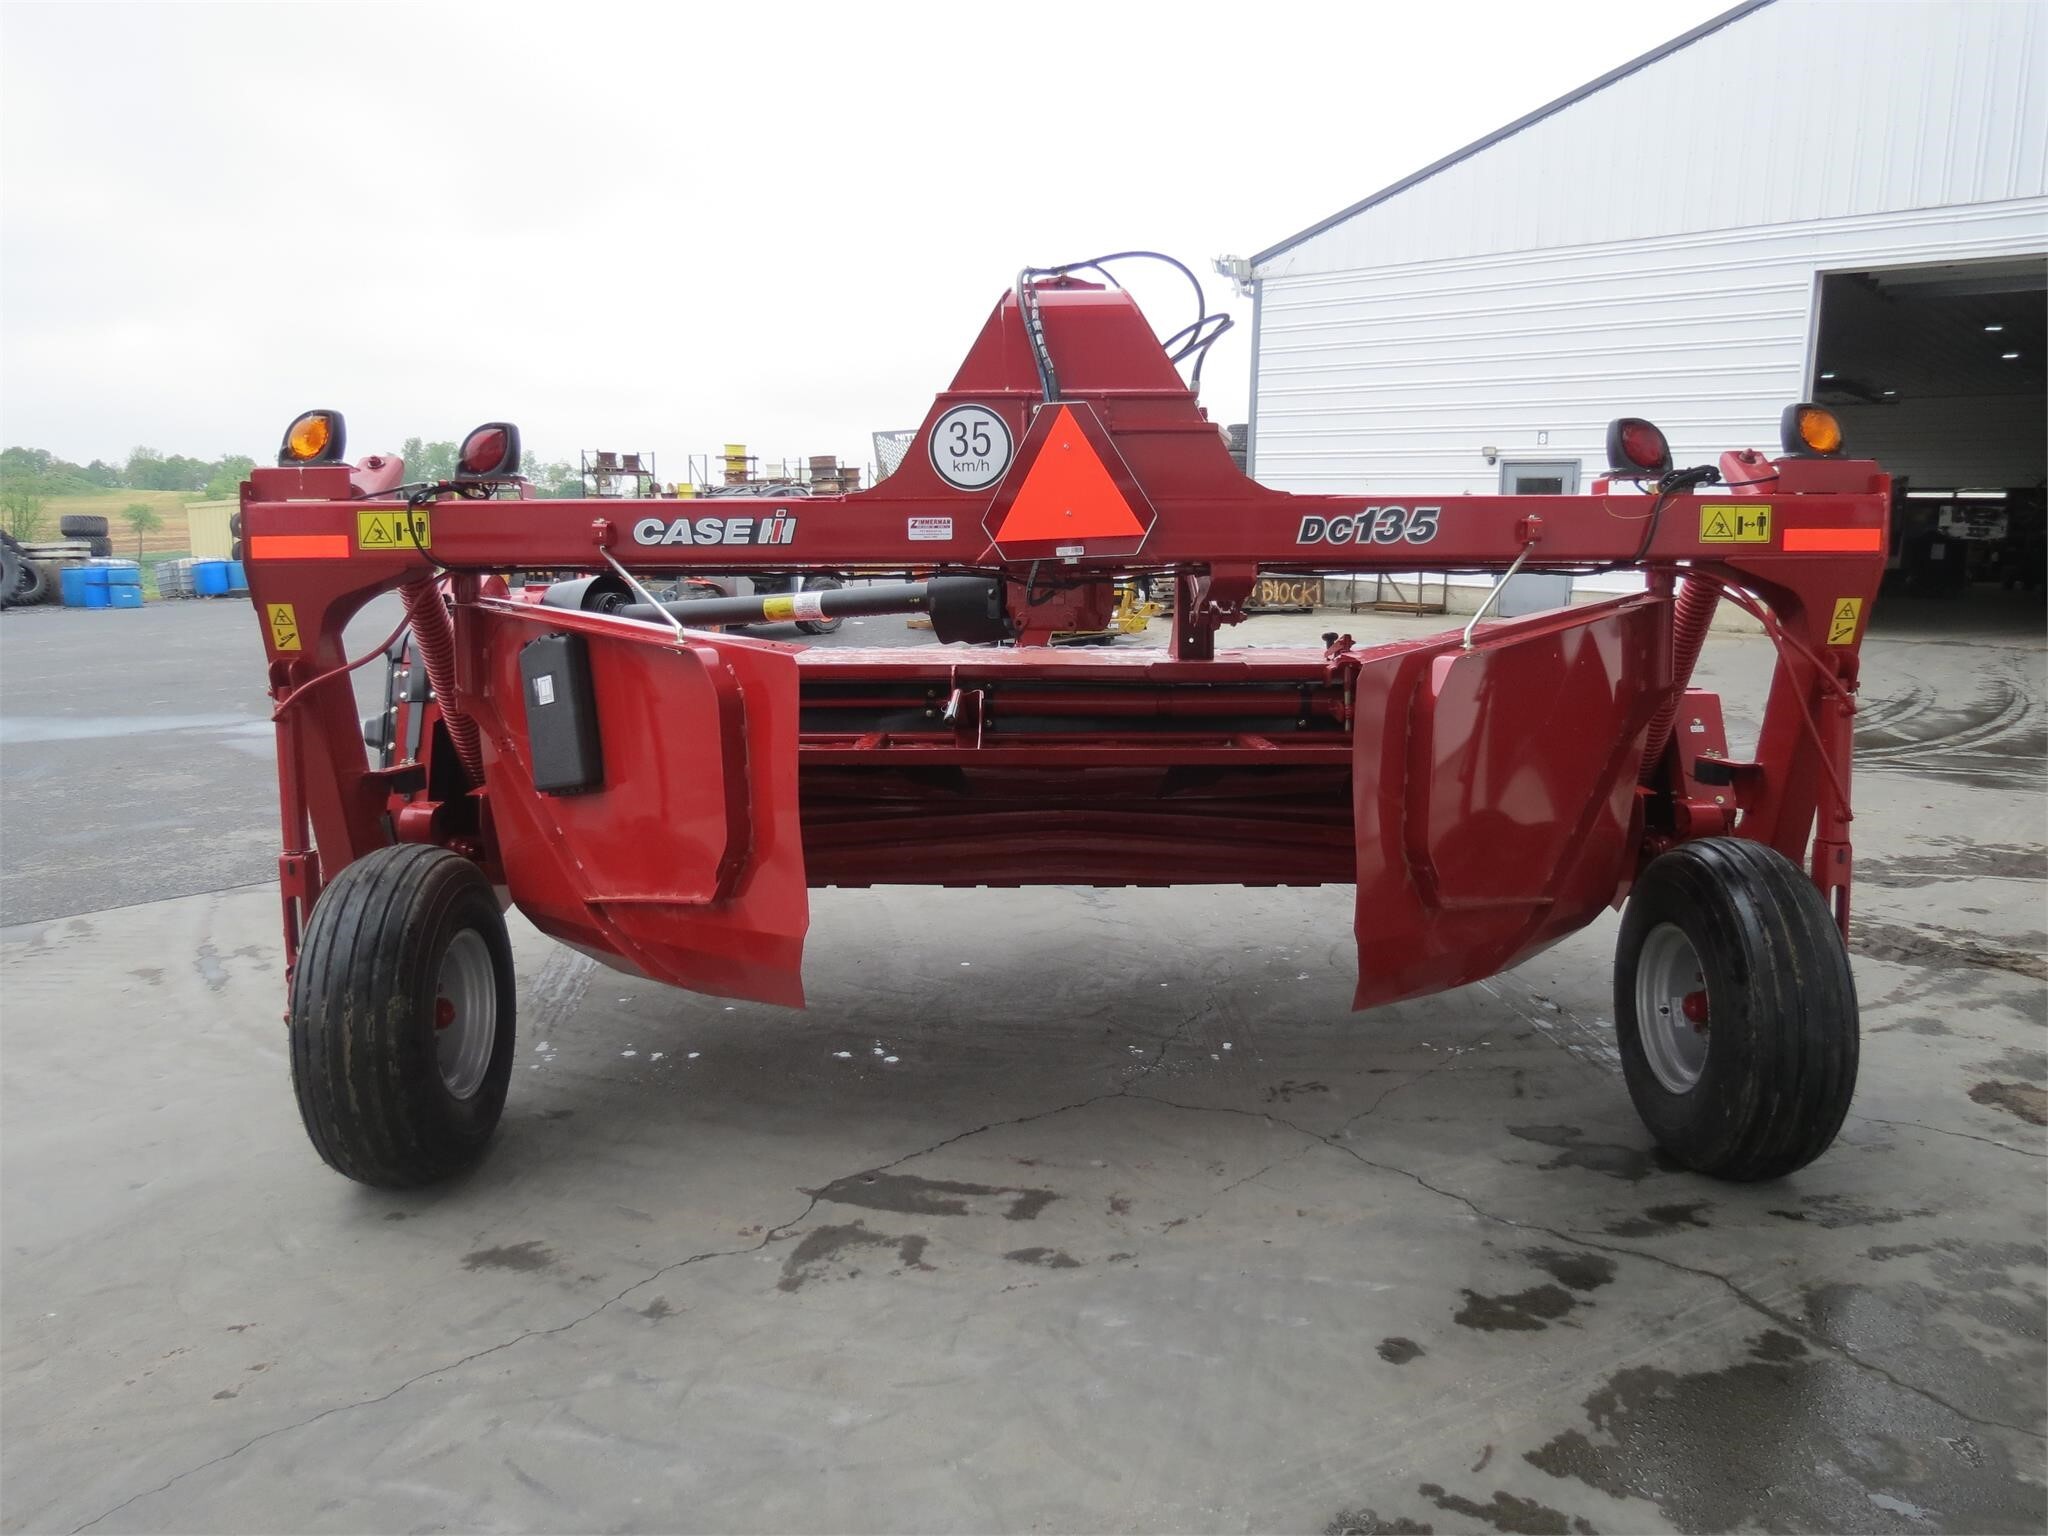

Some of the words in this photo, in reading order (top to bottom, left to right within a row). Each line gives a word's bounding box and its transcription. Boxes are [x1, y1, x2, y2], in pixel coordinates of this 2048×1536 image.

[949, 421, 991, 457] 35
[952, 459, 990, 472] km/h
[633, 518, 754, 545] CASE
[910, 519, 951, 529] ZIMMERMAN
[1296, 505, 1441, 545] DC135
